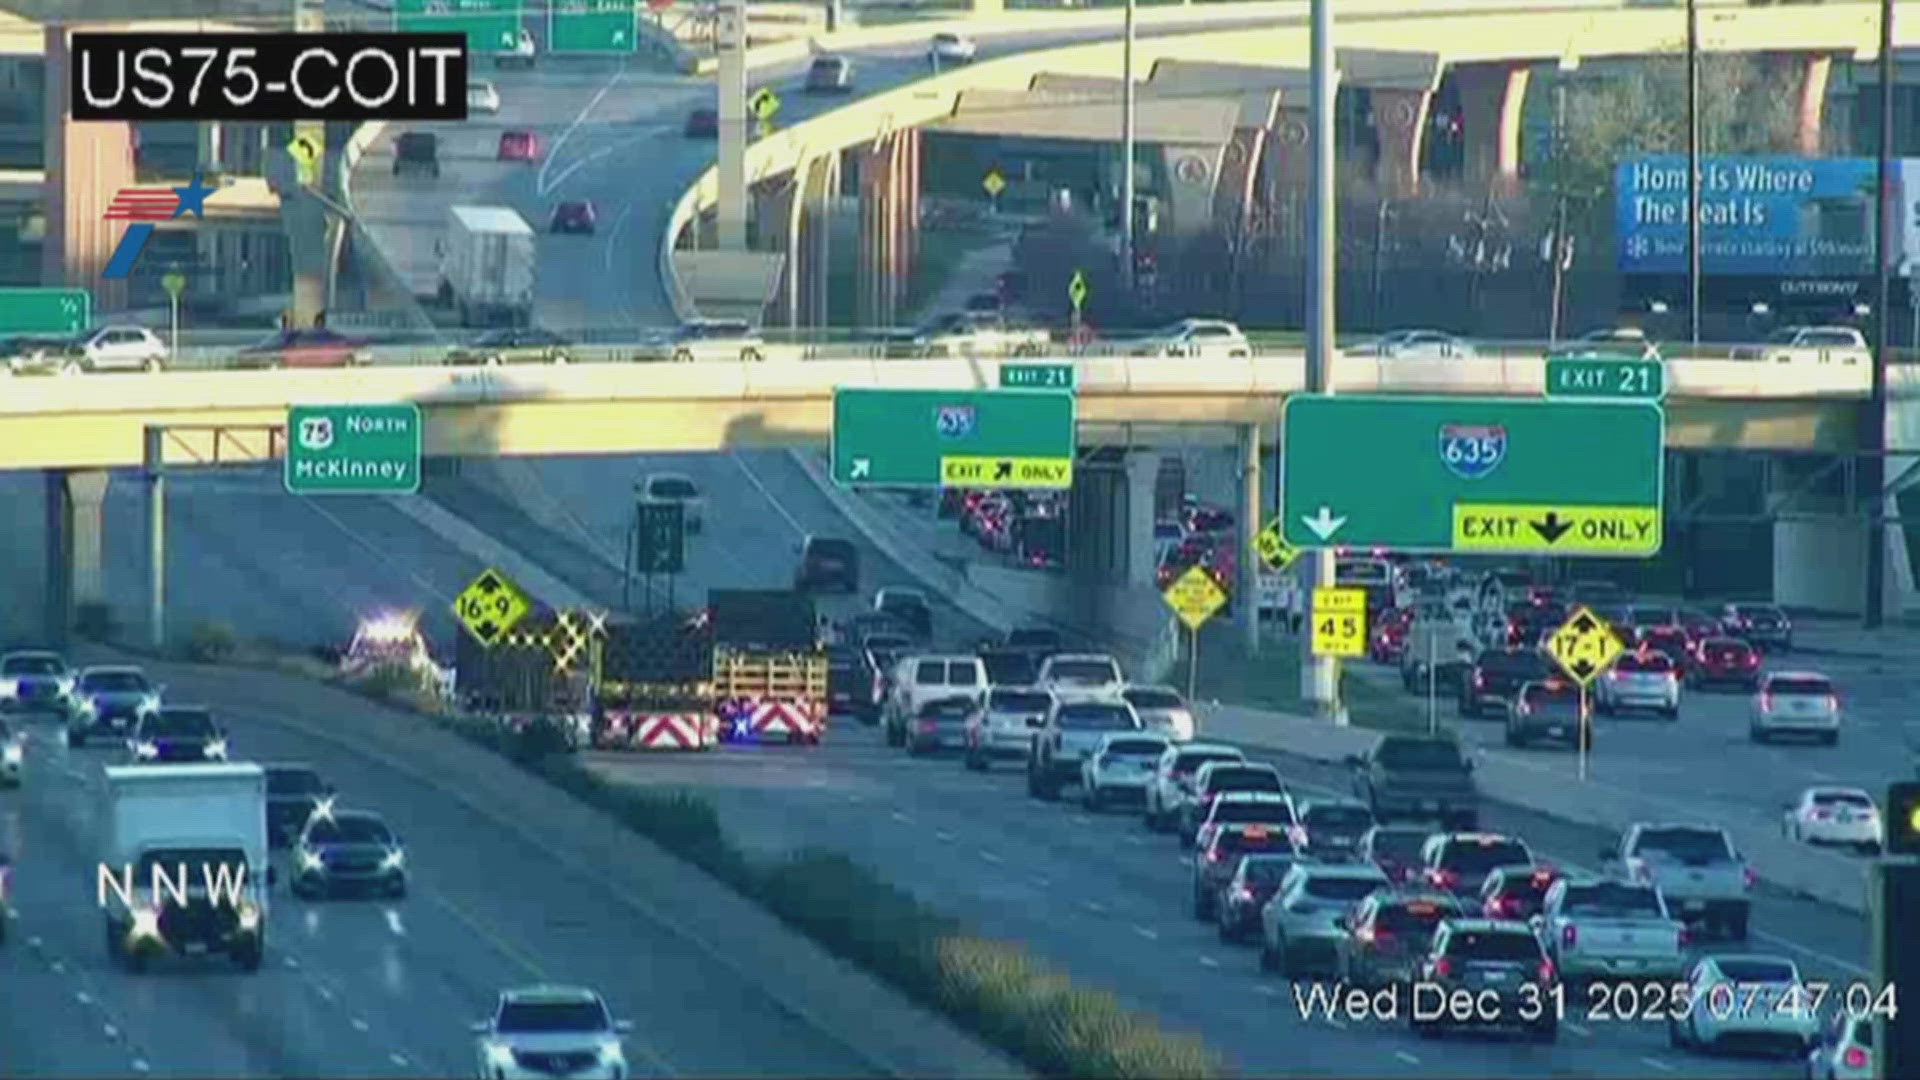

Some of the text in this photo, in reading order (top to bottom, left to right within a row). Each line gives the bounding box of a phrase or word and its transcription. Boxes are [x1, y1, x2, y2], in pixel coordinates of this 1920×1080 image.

[1709, 163, 1730, 191] Is
[1735, 163, 1814, 191] Where
[1634, 197, 1676, 224] The
[1744, 197, 1765, 225] Is
[1045, 368, 1066, 385] 21
[1560, 367, 1650, 392] EXIT 21
[303, 420, 331, 442] 75
[1446, 436, 1498, 464] 635
[295, 457, 407, 481] McKinney
[945, 464, 1067, 480] EXIT ONLY
[1462, 516, 1650, 540] EXIT ONLY
[1318, 616, 1358, 640] 45
